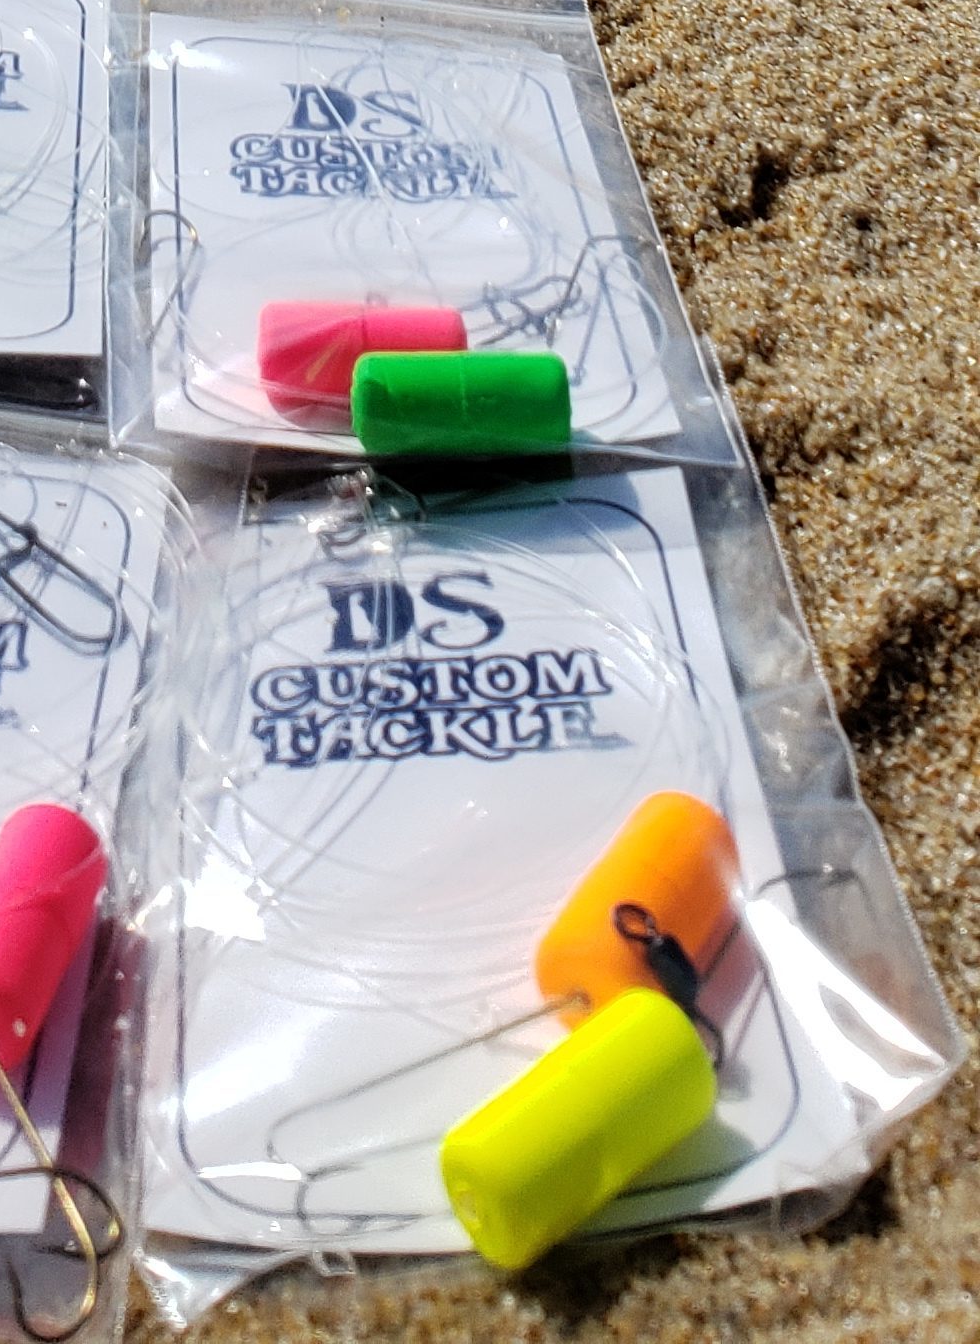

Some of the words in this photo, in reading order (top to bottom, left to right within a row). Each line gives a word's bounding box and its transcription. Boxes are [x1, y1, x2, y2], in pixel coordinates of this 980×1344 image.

[281, 83, 424, 137] DS
[325, 571, 505, 652] DS
[252, 650, 611, 710] CUSTOM
[251, 703, 628, 767] TACKLE
